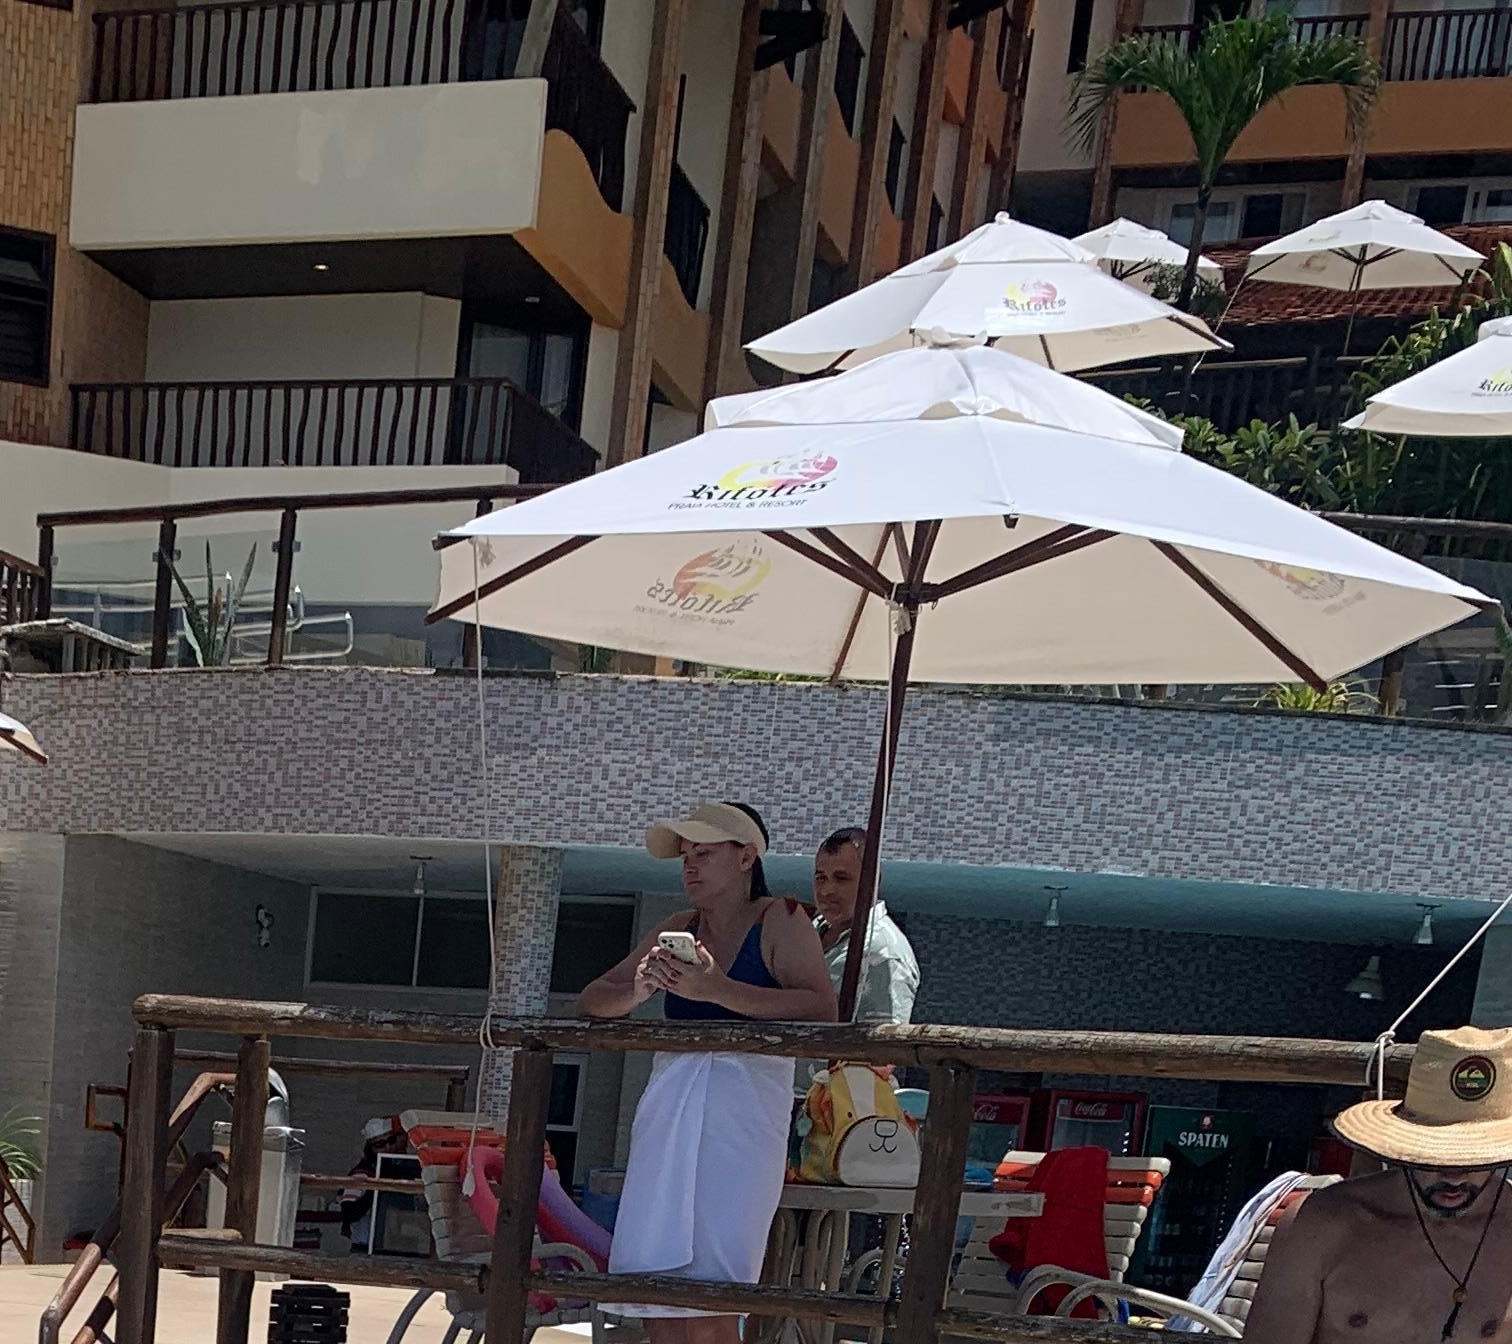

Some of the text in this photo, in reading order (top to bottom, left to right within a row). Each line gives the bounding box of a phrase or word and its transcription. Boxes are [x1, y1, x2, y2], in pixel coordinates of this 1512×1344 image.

[706, 501, 742, 509] HOTEL
[759, 499, 808, 508] RESORT
[1178, 1131, 1230, 1149] SPATEN
